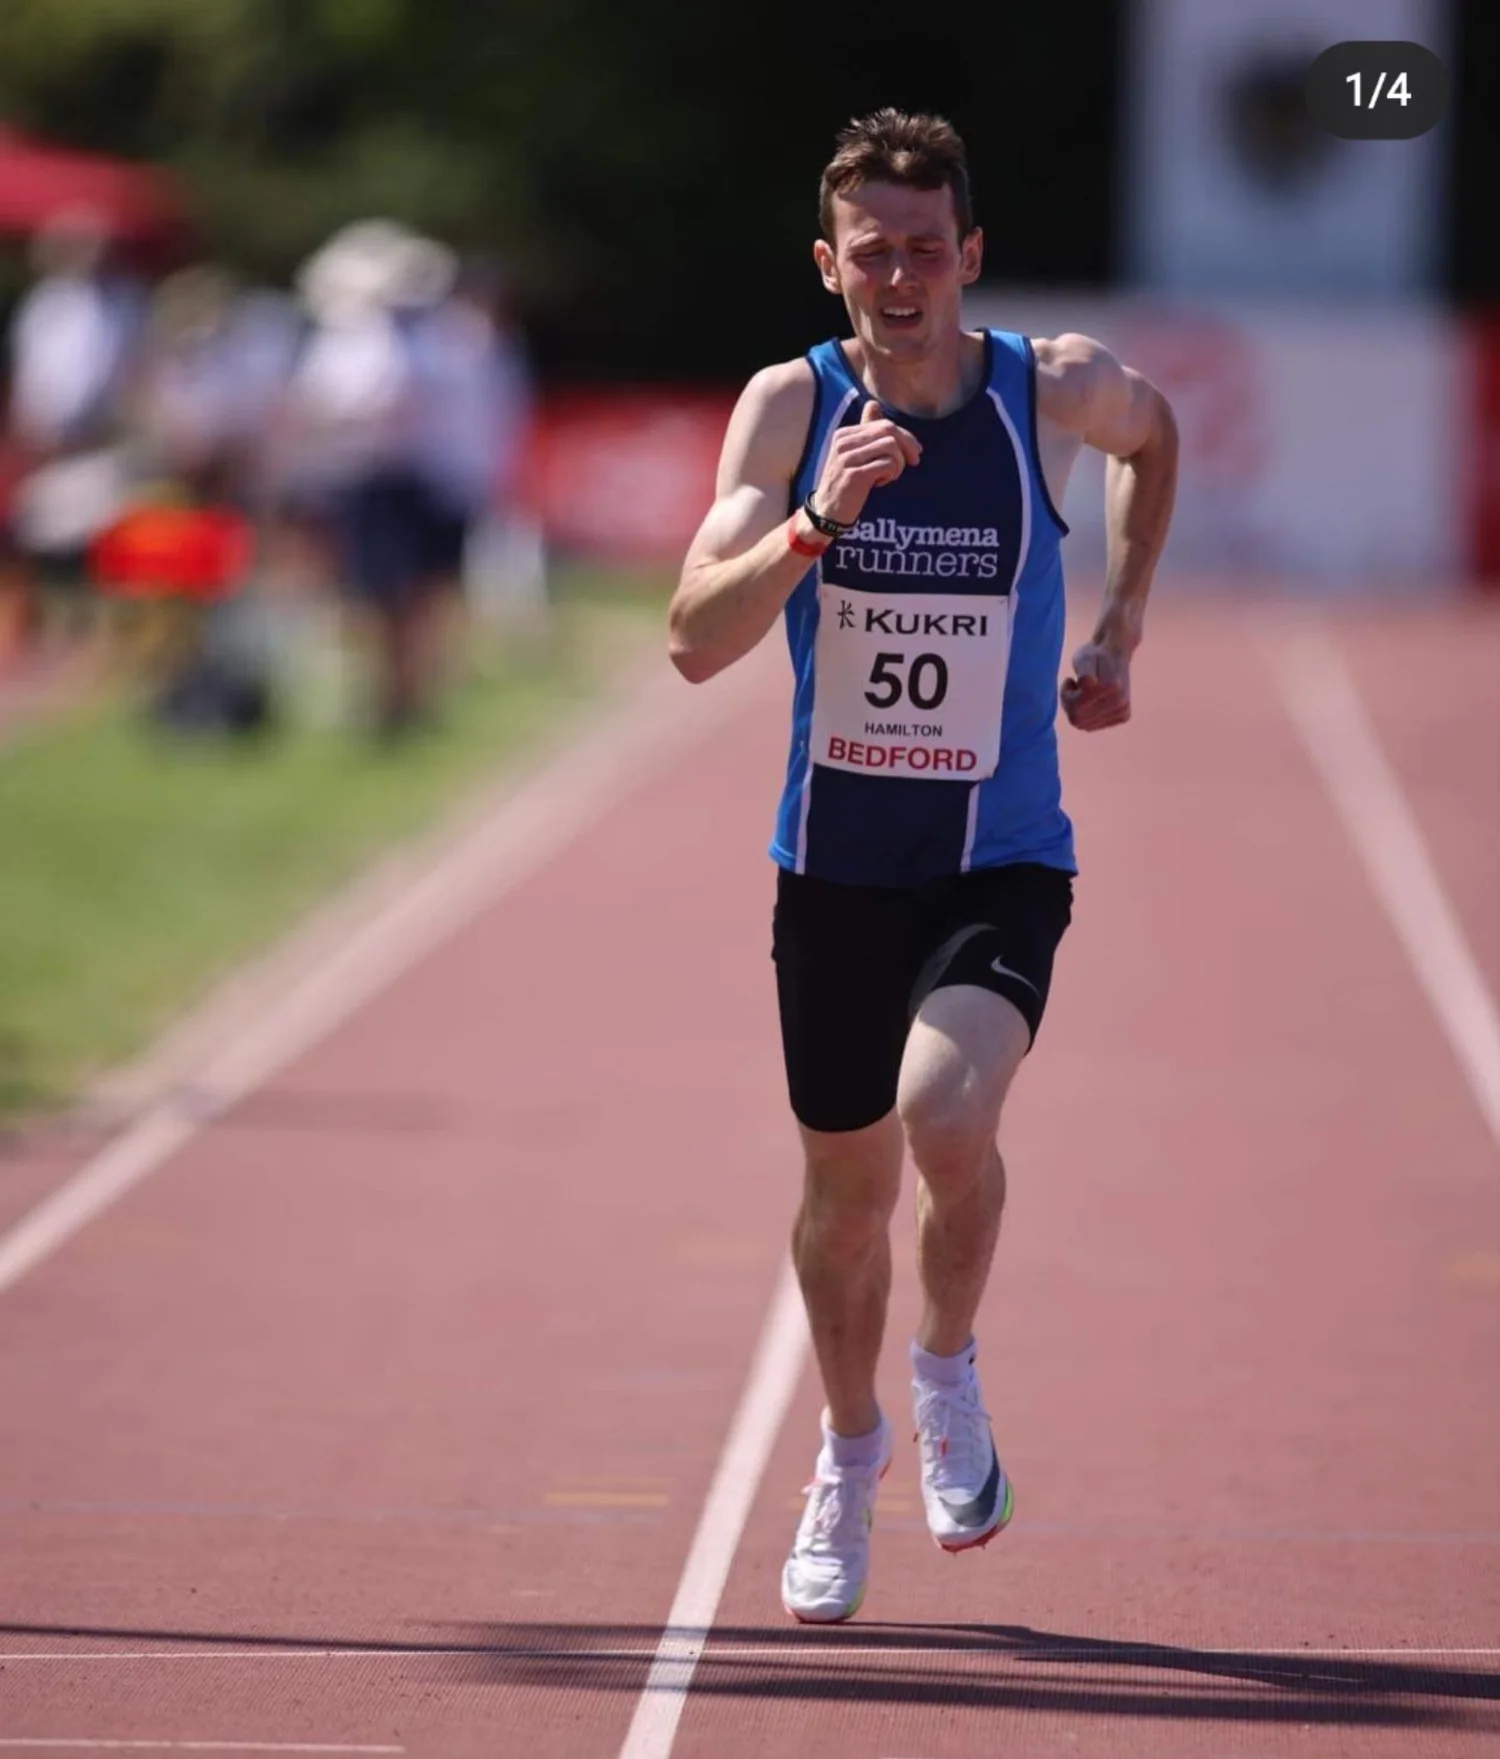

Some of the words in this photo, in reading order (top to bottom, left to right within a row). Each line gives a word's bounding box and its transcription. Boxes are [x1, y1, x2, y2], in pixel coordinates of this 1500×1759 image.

[835, 544, 998, 578] runners
[864, 608, 988, 637] KUKRI
[863, 652, 948, 710] 50
[864, 722, 943, 737] HAMILTON
[827, 737, 977, 772] BEDFORD
